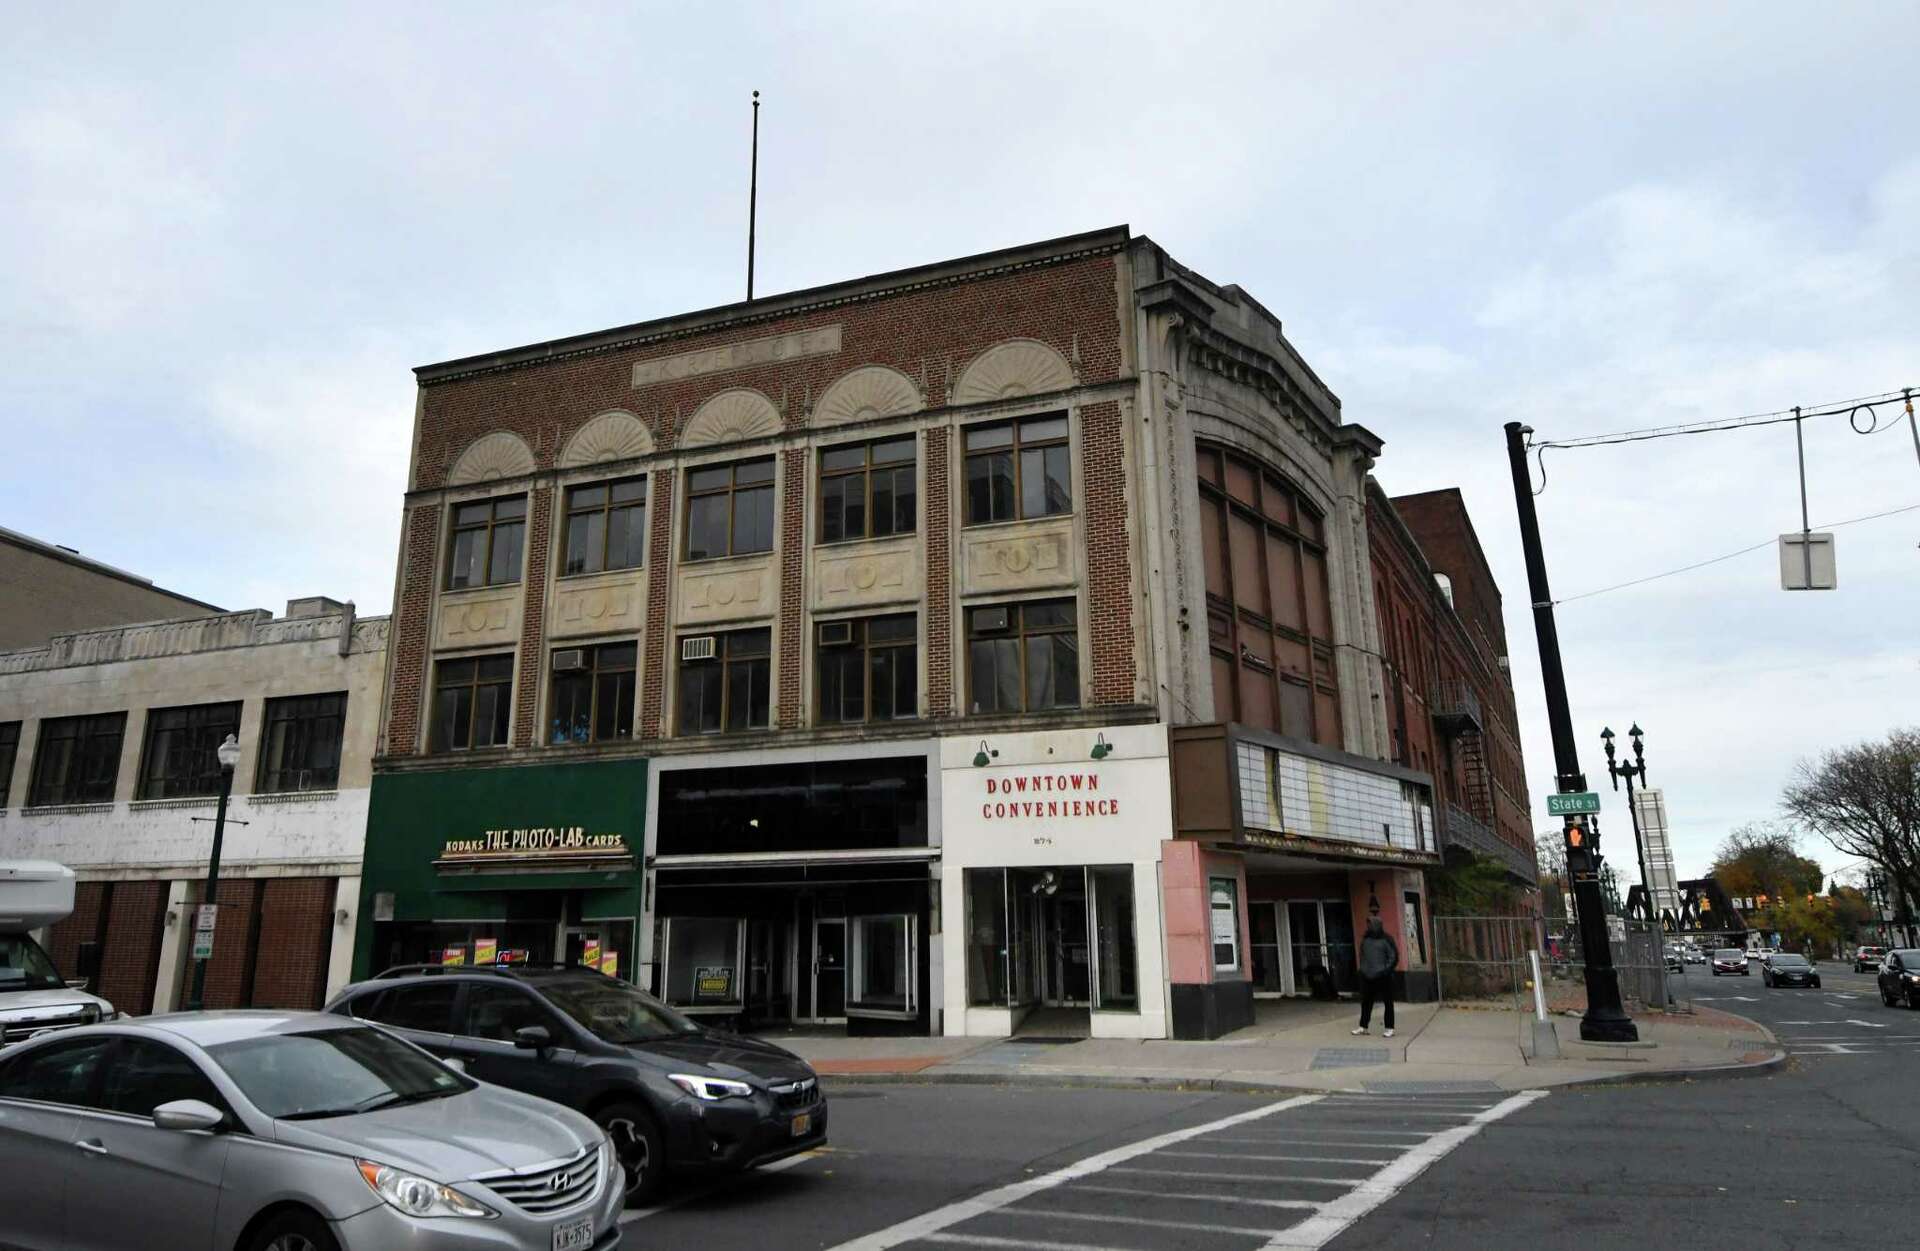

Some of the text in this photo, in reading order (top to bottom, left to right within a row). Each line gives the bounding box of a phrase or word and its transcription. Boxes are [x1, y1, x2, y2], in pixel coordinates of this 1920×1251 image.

[986, 774, 1099, 794] DOWNTOWN
[982, 799, 1119, 819] CONVENIENCE
[1551, 799, 1583, 810] State
[446, 827, 622, 852] KODAKS THE PHOTO-LAB CARDS
